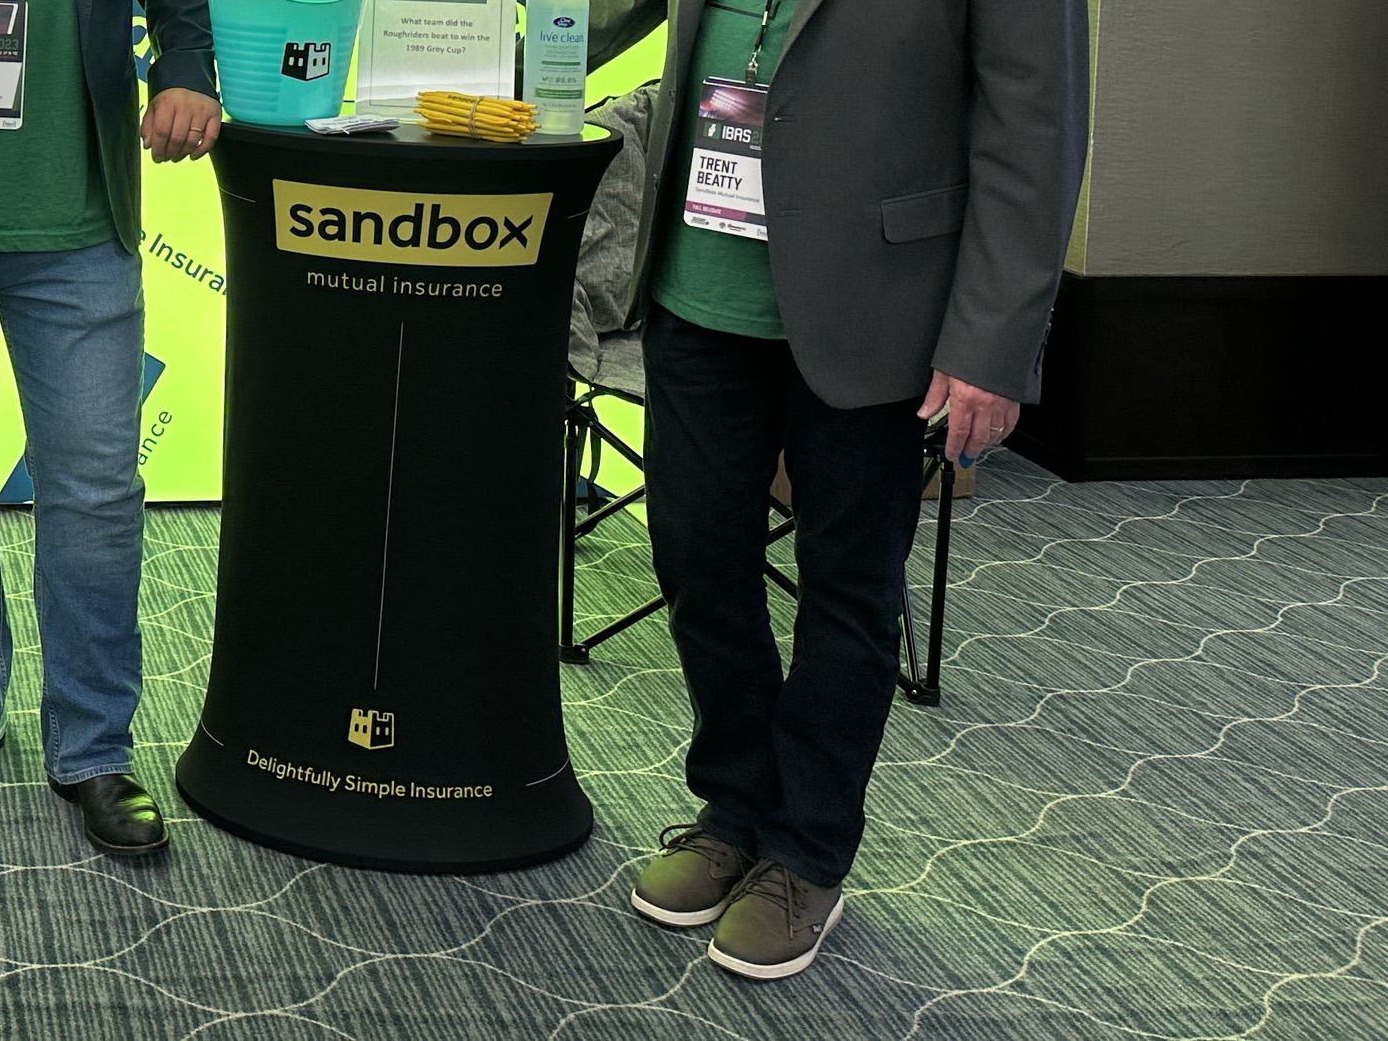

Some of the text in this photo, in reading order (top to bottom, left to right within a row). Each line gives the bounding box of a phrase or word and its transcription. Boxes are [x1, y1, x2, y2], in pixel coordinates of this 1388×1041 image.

[401, 18, 422, 26] What
[446, 19, 458, 27] did
[460, 20, 473, 28] the
[383, 30, 429, 40] Roughriders
[431, 32, 448, 40] beat
[477, 34, 490, 42] the
[540, 30, 584, 43] live clean
[406, 44, 466, 54] 1989 Grey Cup?
[700, 156, 738, 174] TRENT
[697, 171, 742, 191] BEATTY
[289, 200, 533, 250] sandbox
[307, 269, 503, 299] mutual insurance
[247, 750, 493, 800] Delightfully Simple Insurance
